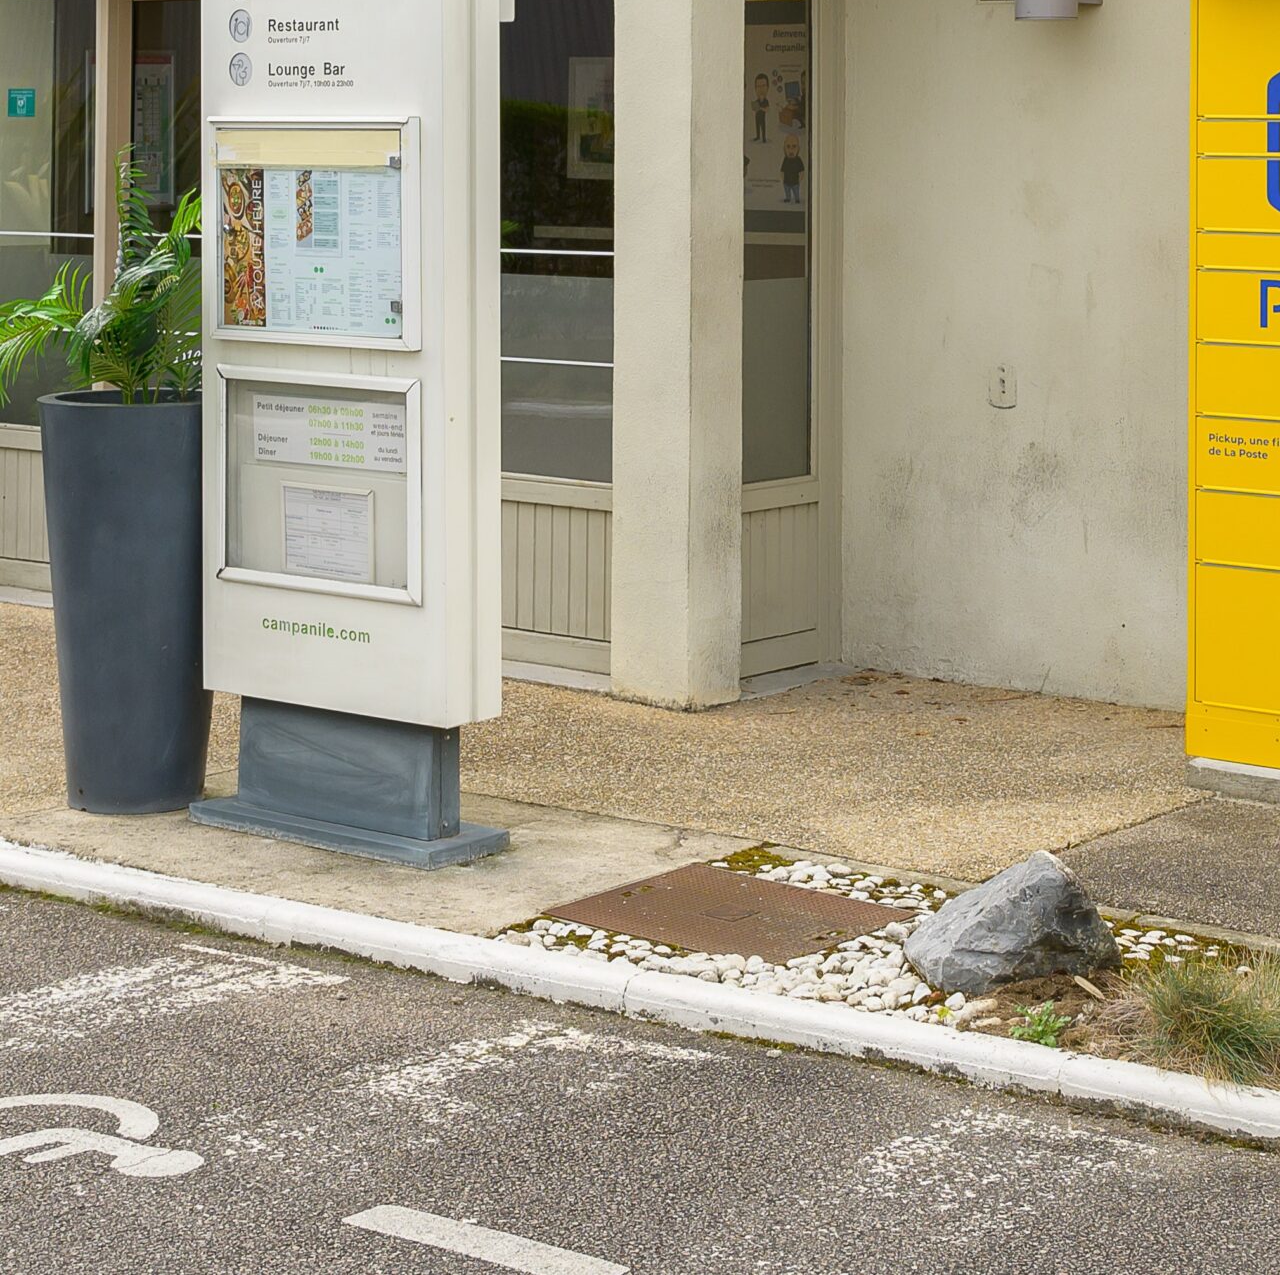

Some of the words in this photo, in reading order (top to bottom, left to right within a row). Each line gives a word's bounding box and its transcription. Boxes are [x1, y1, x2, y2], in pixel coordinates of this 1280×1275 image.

[268, 18, 340, 32] Restaurant
[268, 36, 298, 44] Ouverture
[268, 63, 315, 79] Lounge
[323, 62, 346, 75] Bar
[252, 180, 263, 233] HEURE
[252, 238, 263, 292] TOUTE
[257, 401, 273, 411] Petit
[372, 412, 397, 420] semaine
[1209, 433, 1247, 446] Pickup,
[1249, 437, 1269, 446] une
[1209, 446, 1221, 455] de
[1224, 448, 1236, 457] La
[1239, 449, 1268, 459] Poste
[262, 618, 370, 643] campanile.com
